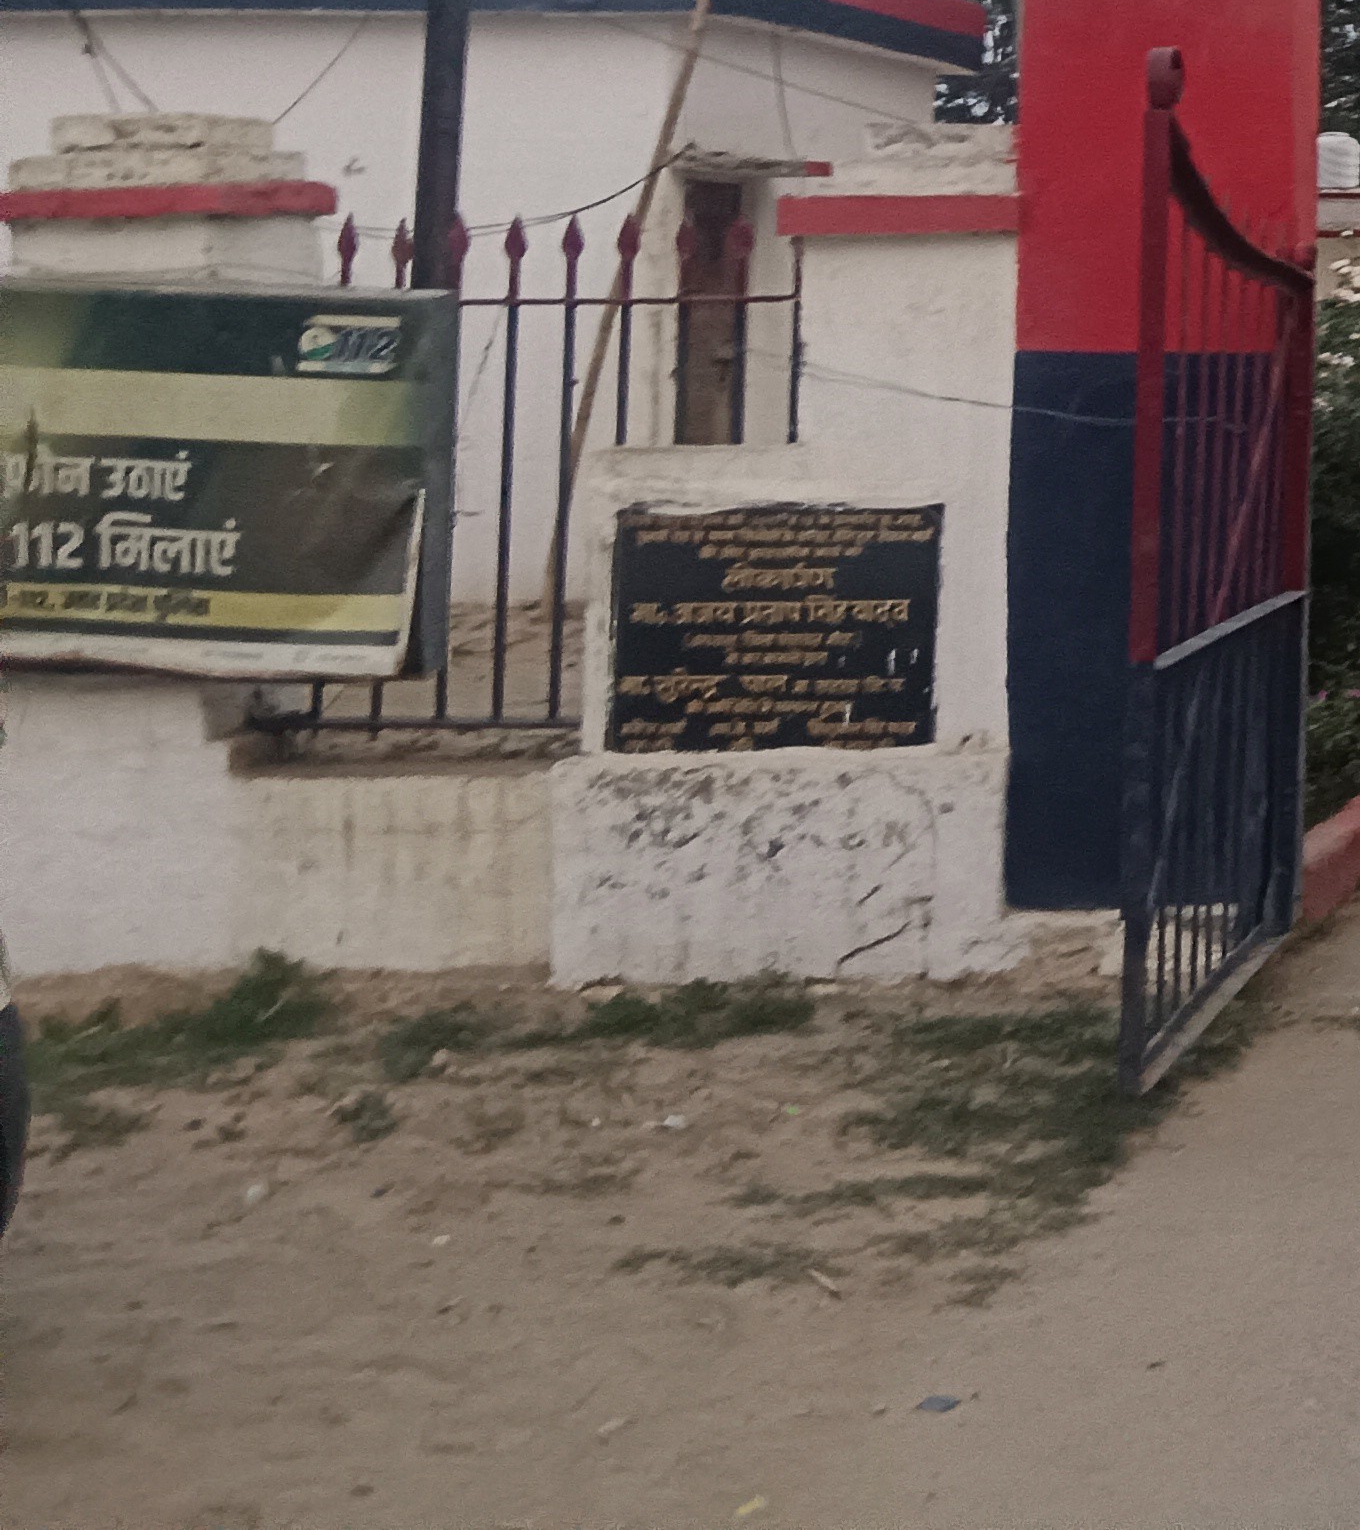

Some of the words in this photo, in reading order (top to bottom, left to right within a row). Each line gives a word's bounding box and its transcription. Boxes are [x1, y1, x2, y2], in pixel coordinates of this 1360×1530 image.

[101, 450, 192, 502] उठाएं
[8, 520, 85, 569] 112
[94, 511, 241, 577] मिलाएं
